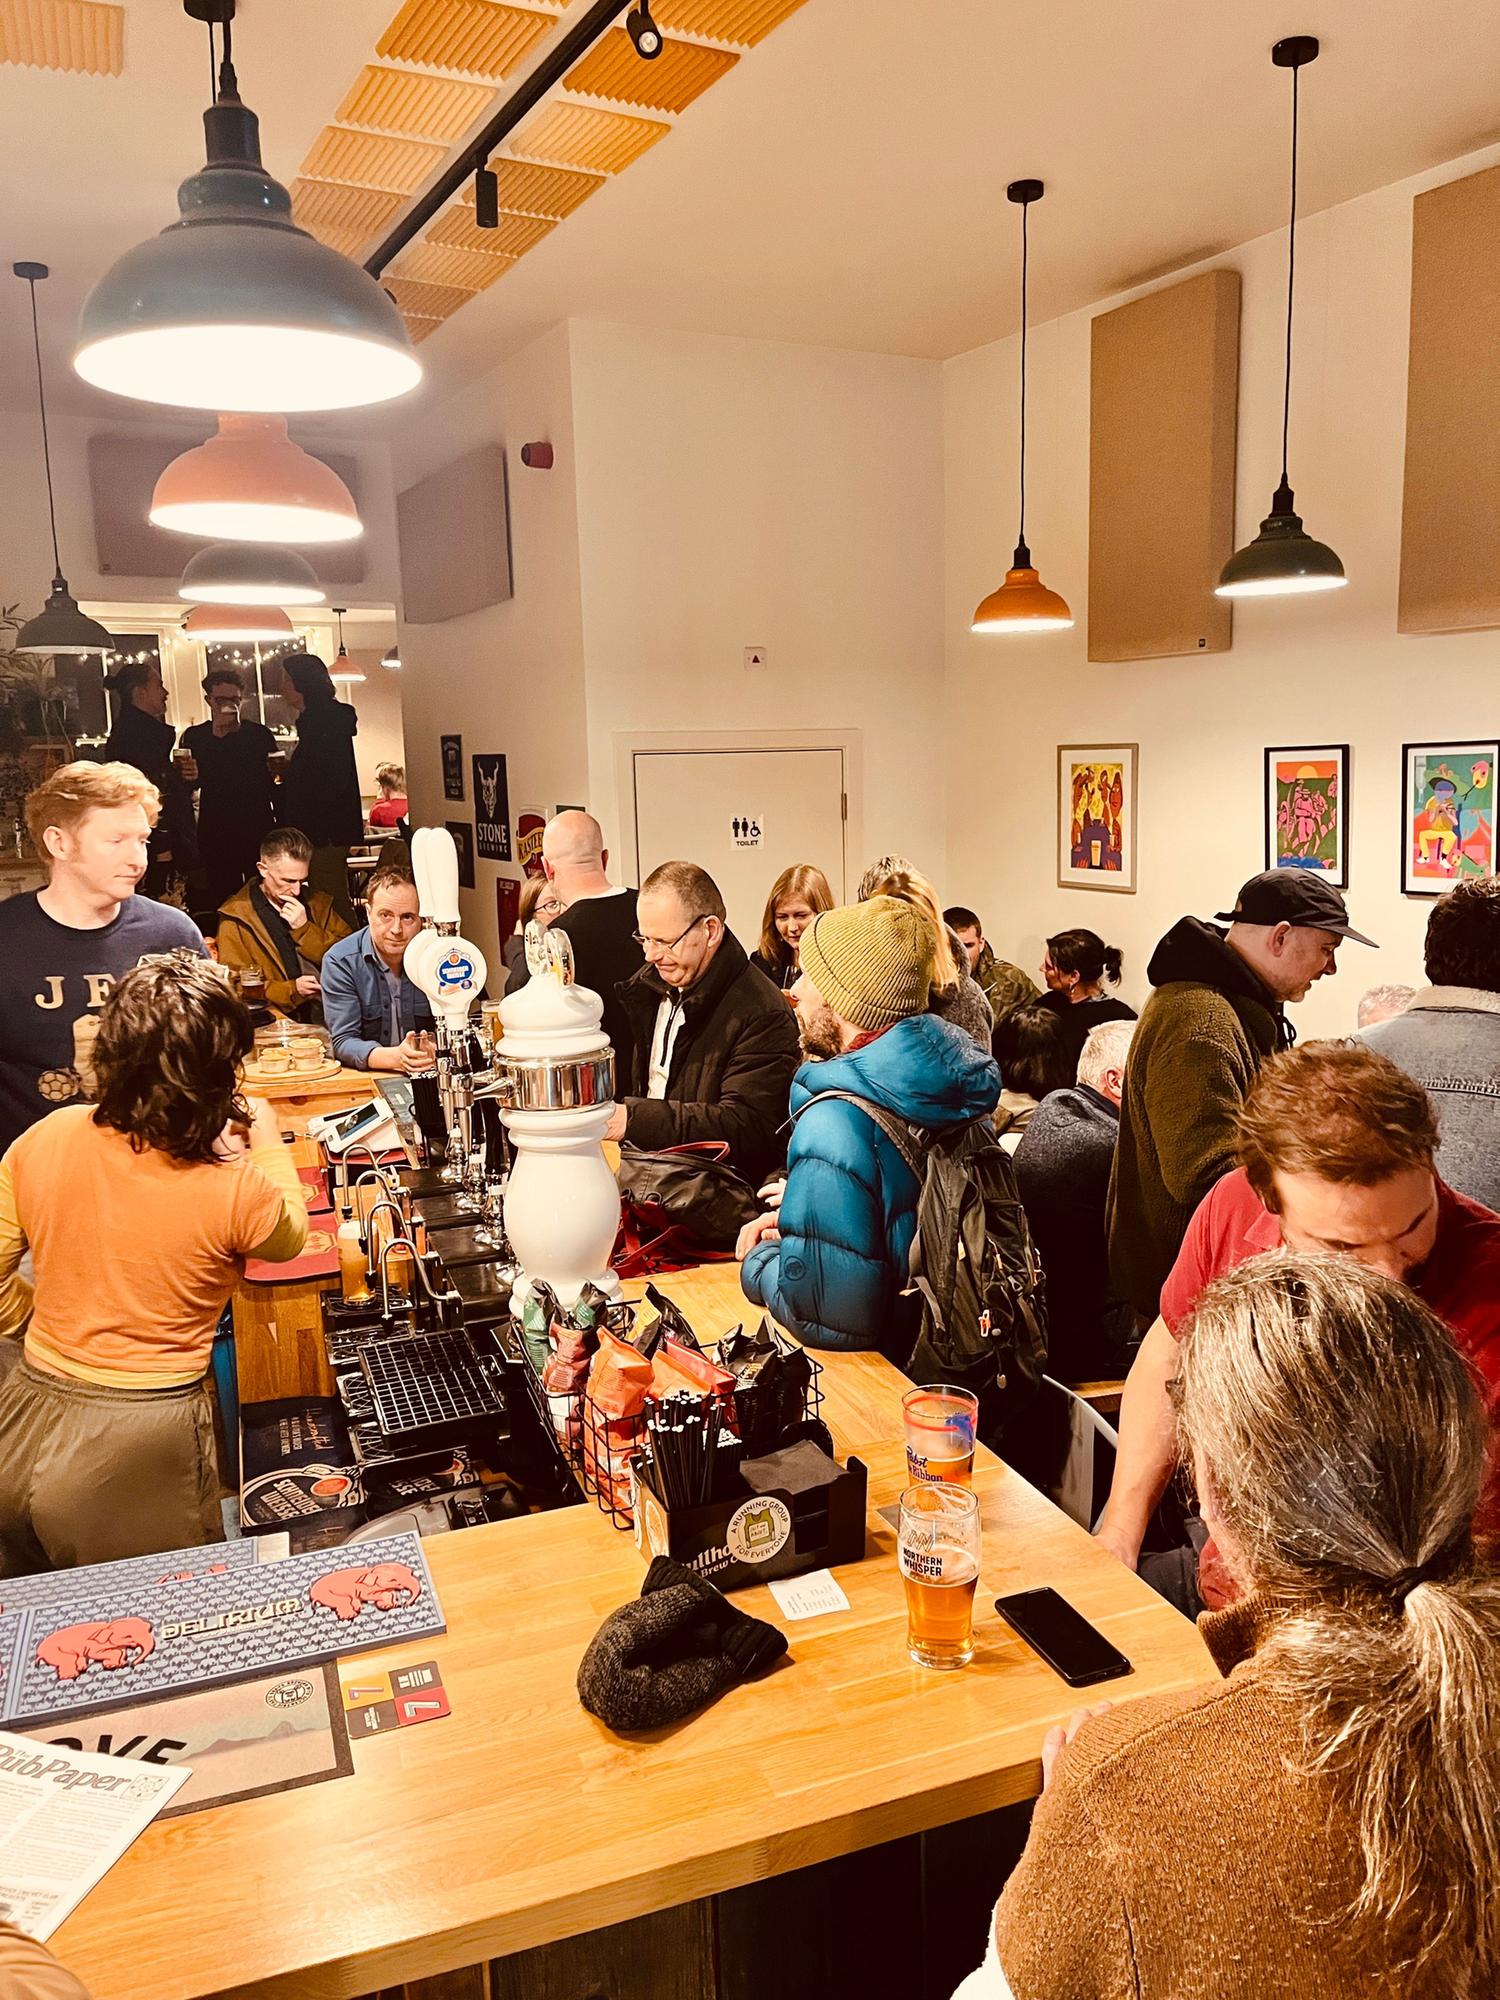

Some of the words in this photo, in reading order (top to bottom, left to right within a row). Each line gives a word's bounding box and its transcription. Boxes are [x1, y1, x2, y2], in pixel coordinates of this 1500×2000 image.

[478, 823, 507, 844] STONE
[906, 1445, 928, 1468] Pabst
[912, 1465, 943, 1482] Ribbon
[273, 1479, 323, 1514] SCHNEIDE
[733, 1500, 767, 1527] RUNNING
[768, 1501, 788, 1523] GROUP
[735, 1544, 750, 1557] FOR
[750, 1531, 787, 1559] EVERYONE
[903, 1547, 943, 1566] NORTHERN
[682, 1544, 732, 1571] ullho
[700, 1559, 728, 1578] Brew
[903, 1556, 942, 1576] WHISPER
[160, 1598, 304, 1640] DELIRIUM
